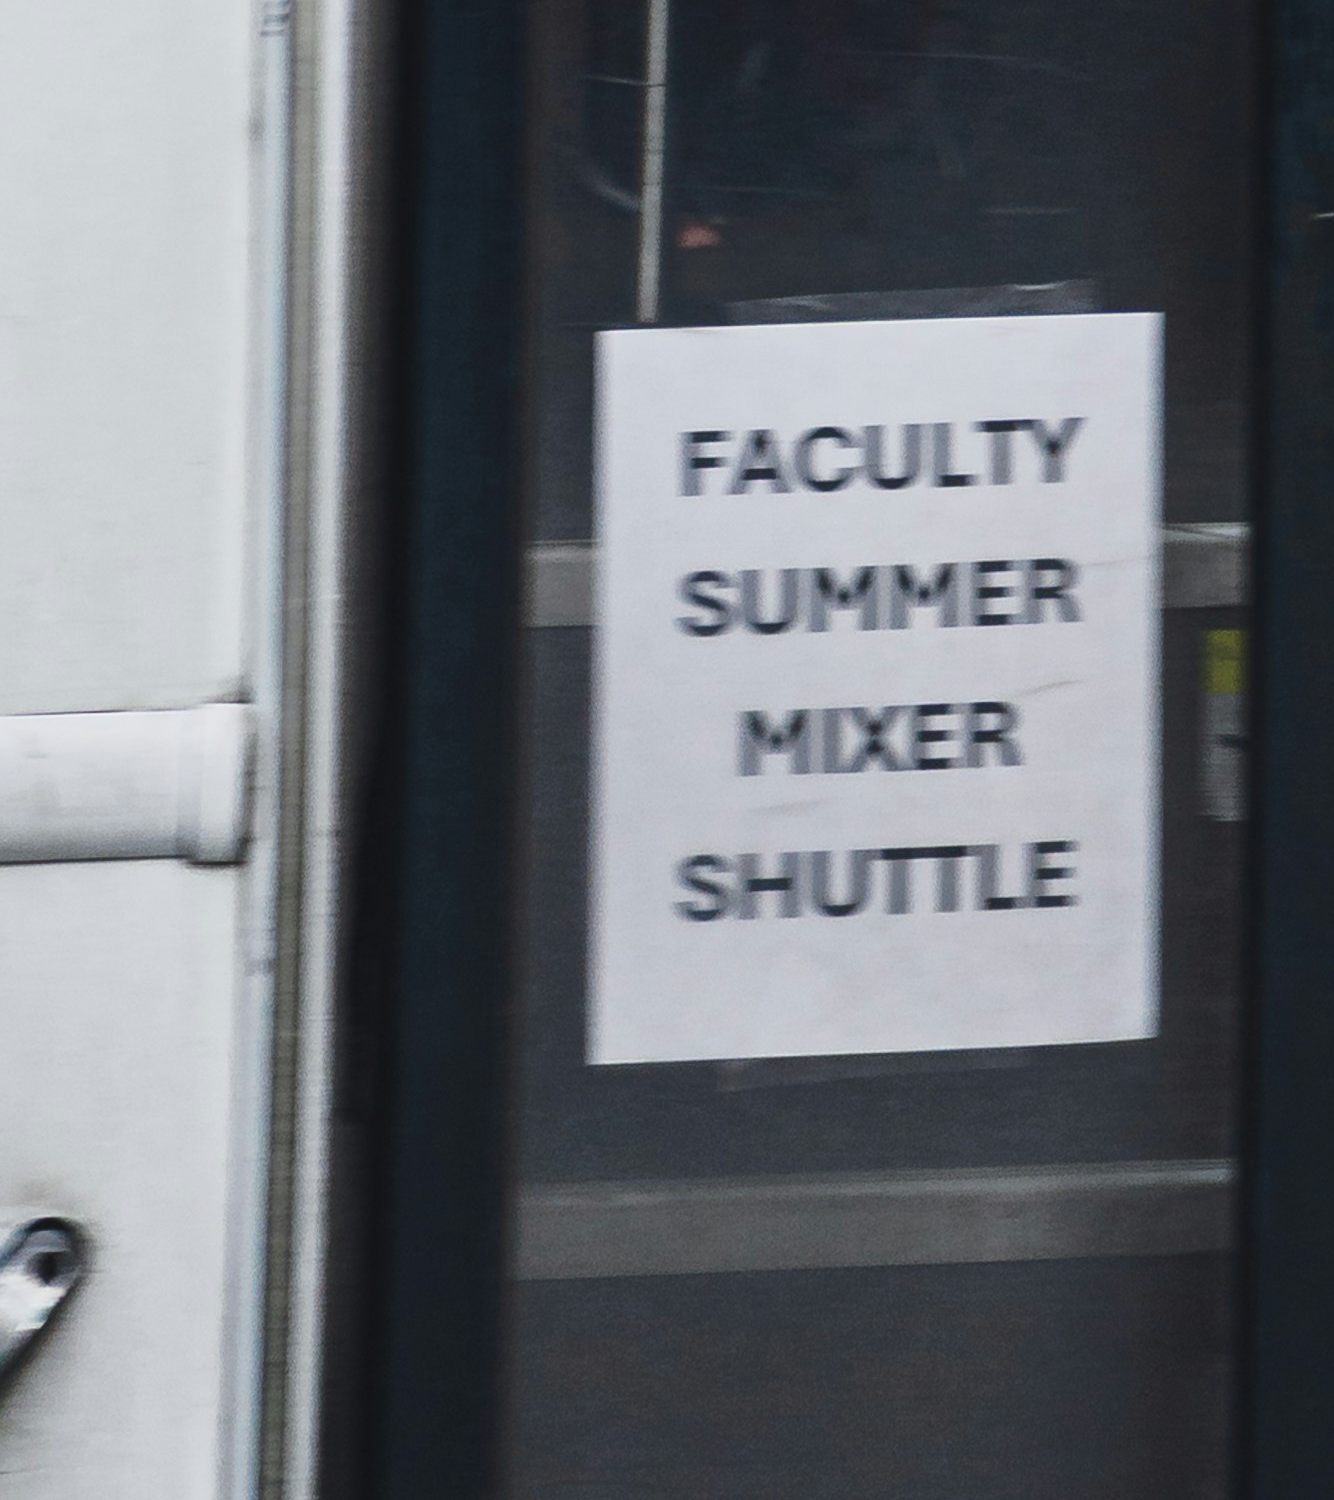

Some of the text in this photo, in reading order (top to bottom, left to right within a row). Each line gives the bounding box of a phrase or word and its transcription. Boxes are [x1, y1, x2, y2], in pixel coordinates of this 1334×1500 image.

[676, 415, 1088, 499] FACULTY
[672, 556, 1086, 640] SUMMER
[734, 699, 1024, 779] MIXER
[671, 838, 1081, 924] SHUTTLE
